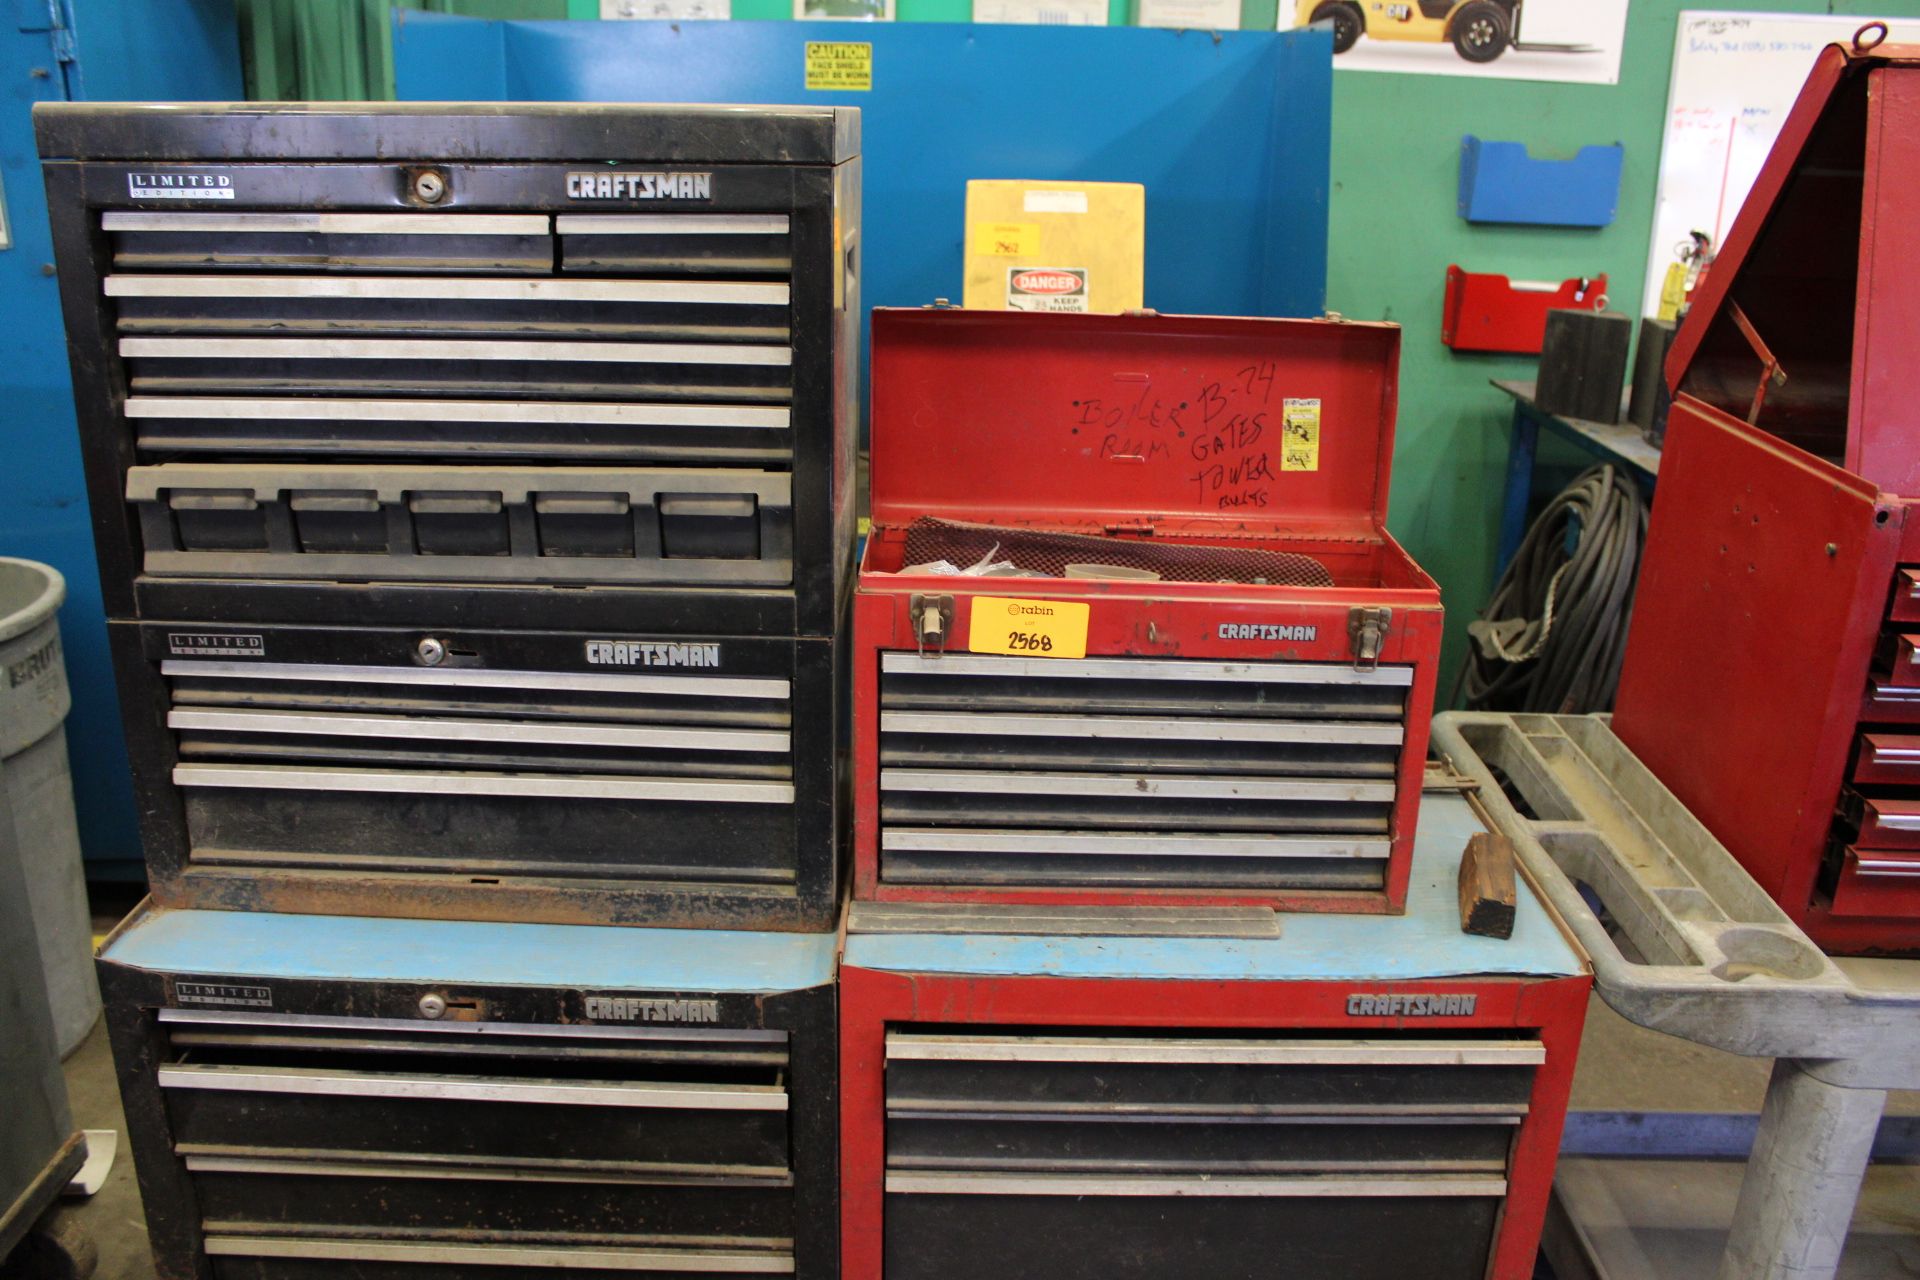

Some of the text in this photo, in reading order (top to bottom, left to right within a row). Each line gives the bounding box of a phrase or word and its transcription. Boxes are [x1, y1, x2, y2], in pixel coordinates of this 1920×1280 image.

[1387, 4, 1408, 19] CAT
[808, 44, 869, 58] CAUTION
[136, 176, 230, 187] LIMITED
[566, 172, 712, 199] CRAFTSMAN
[143, 189, 225, 197] EDITION
[1020, 275, 1076, 289] DANGER
[1050, 305, 1083, 313] HANDS
[1191, 412, 1267, 461] GATES
[1021, 606, 1054, 616] rabin
[1218, 623, 1317, 641] CRAFTSMAN
[174, 636, 260, 647] LIMITED
[1008, 631, 1053, 652] 2568
[585, 640, 720, 667] CRAFTSMAN
[182, 986, 267, 998] LIMITED
[584, 997, 719, 1023] CRAFTSMAN
[1347, 994, 1477, 1016] CRAFTSMAN
